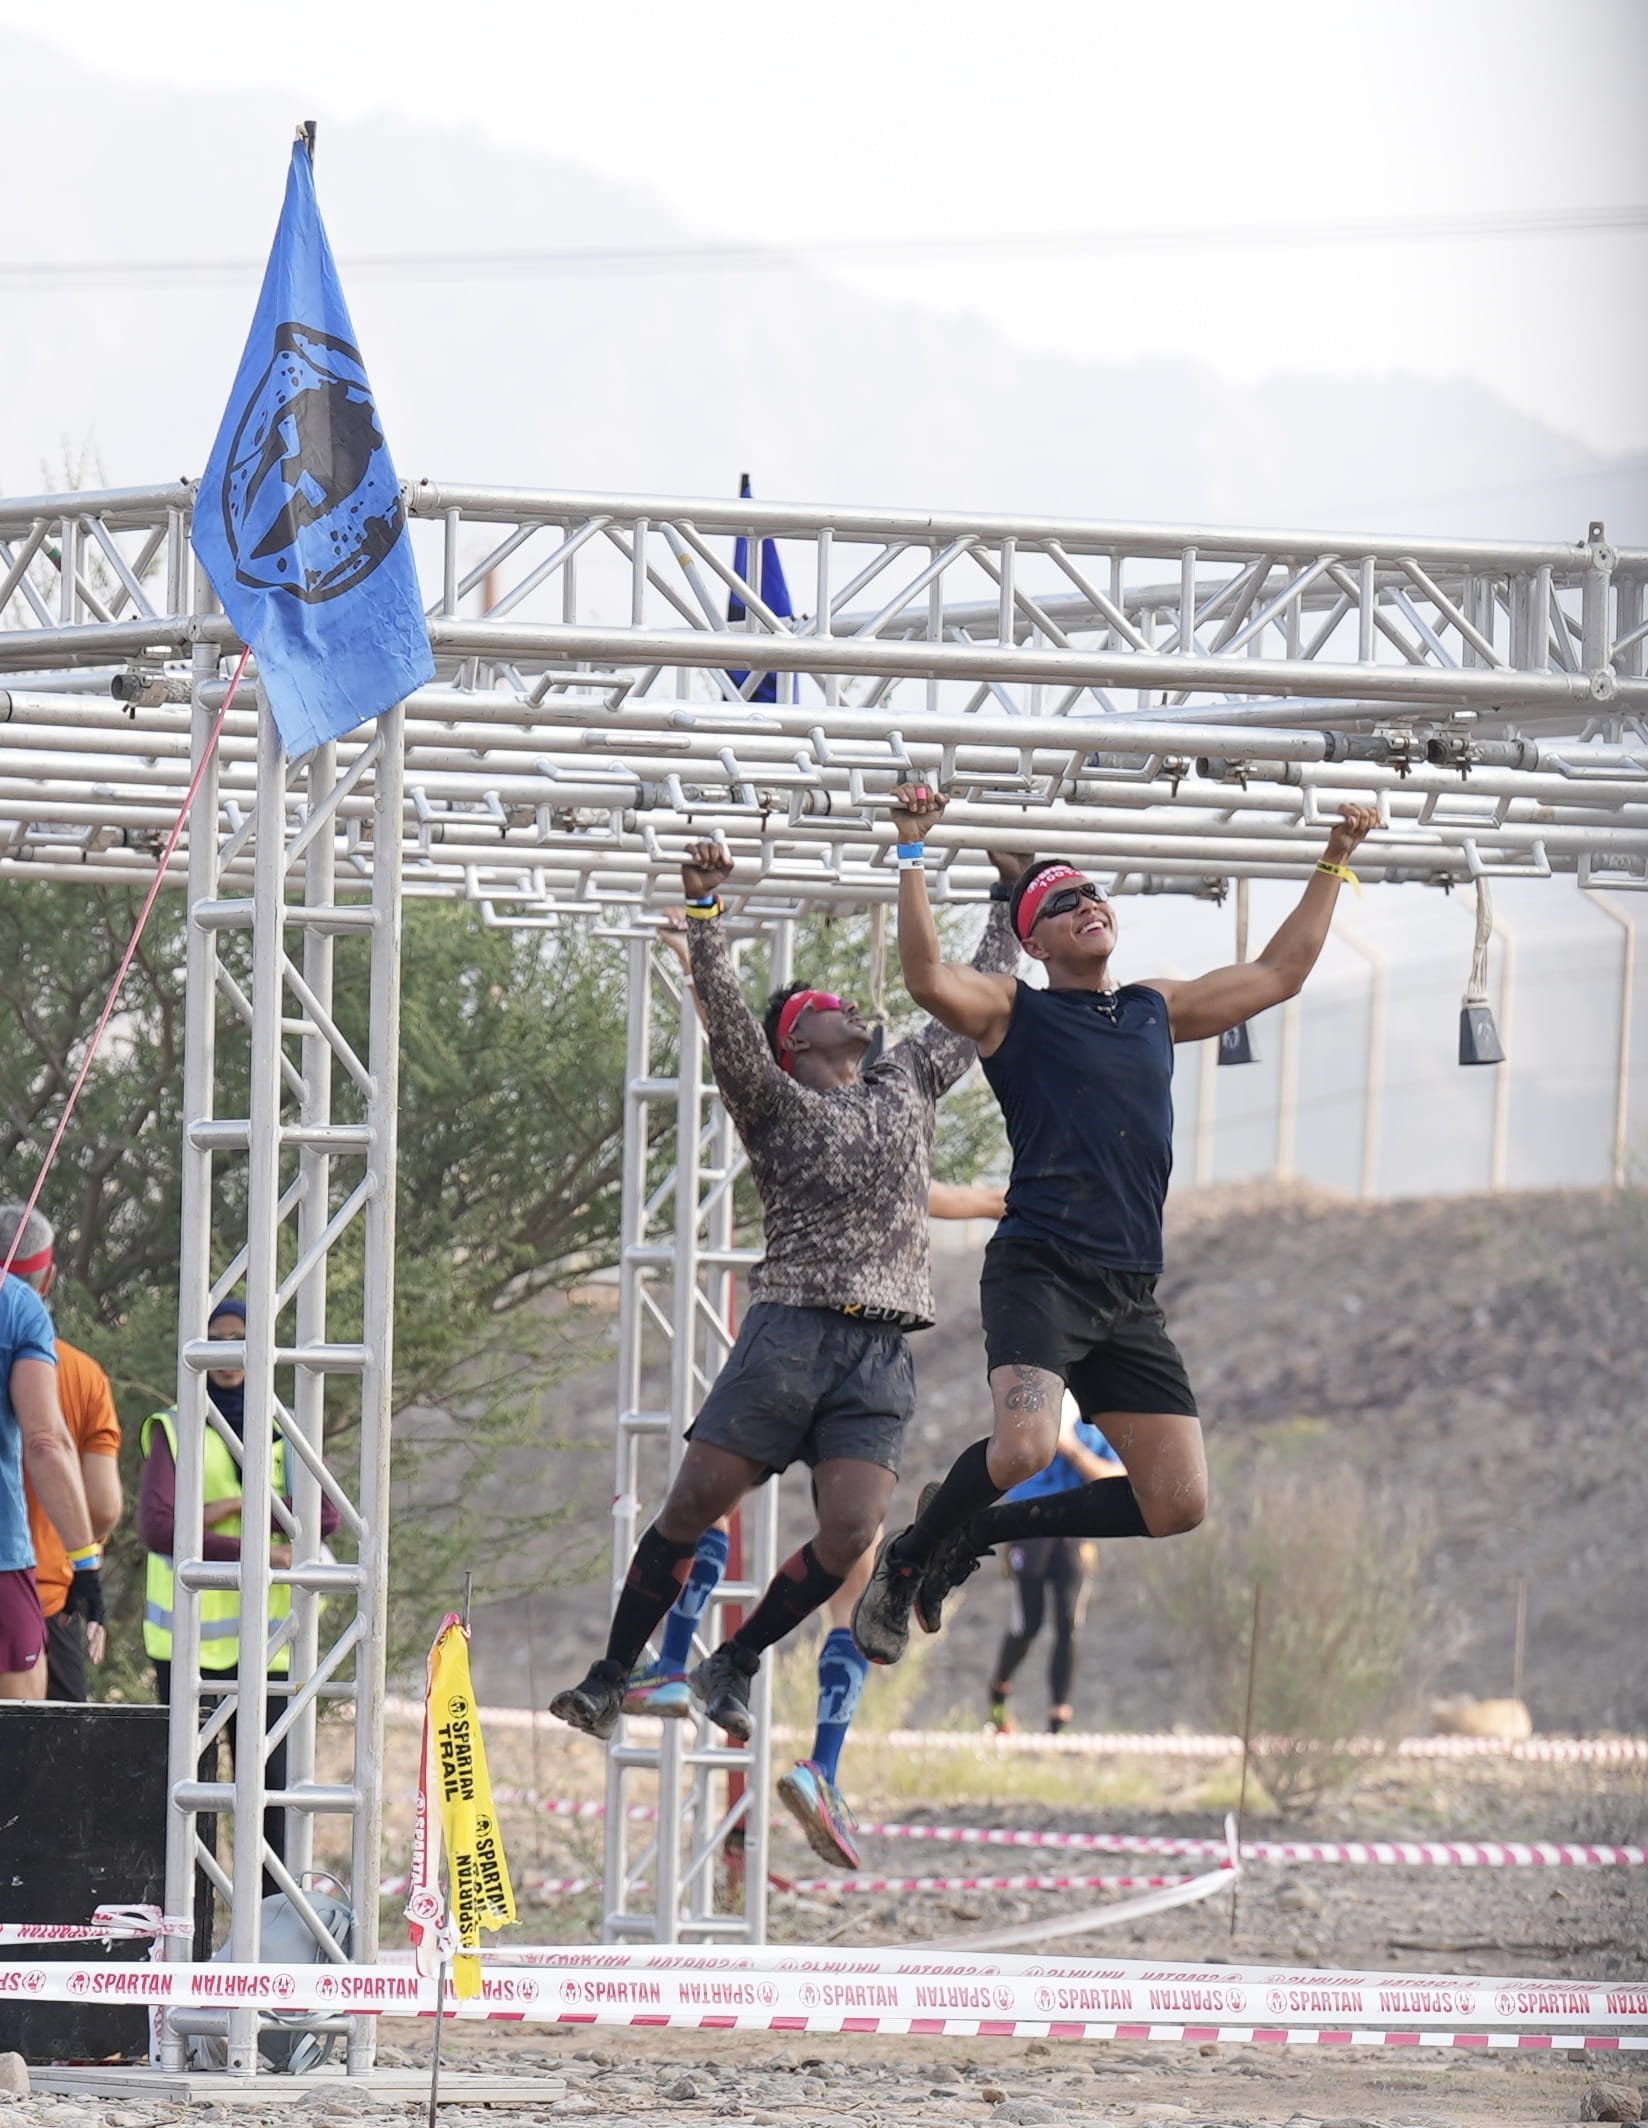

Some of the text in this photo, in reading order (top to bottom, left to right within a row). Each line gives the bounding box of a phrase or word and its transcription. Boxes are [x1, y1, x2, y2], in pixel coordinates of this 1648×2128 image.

[438, 1723, 458, 1802] TRAIL
[452, 1720, 474, 1800] SPARTAN
[475, 1838, 509, 1917] SPARTAN
[456, 1854, 473, 1934] SPARTAN
[92, 1973, 173, 1995] SPARTAN
[191, 1975, 270, 1997] SPARTAN
[341, 1977, 418, 1999] SPARTAN
[584, 1982, 660, 2003] SPARTAN
[679, 1983, 755, 2004] SPARTAN
[823, 1985, 898, 2007] SPARTAN
[916, 1987, 991, 2008] SPARTAN
[1058, 1988, 1132, 2010] SPARTAN
[1150, 1990, 1223, 2011] SPARTAN
[1290, 1991, 1363, 2012] SPARTAN
[1379, 1992, 1453, 2013] SPARTAN
[1518, 1993, 1591, 2014] SPARTAN
